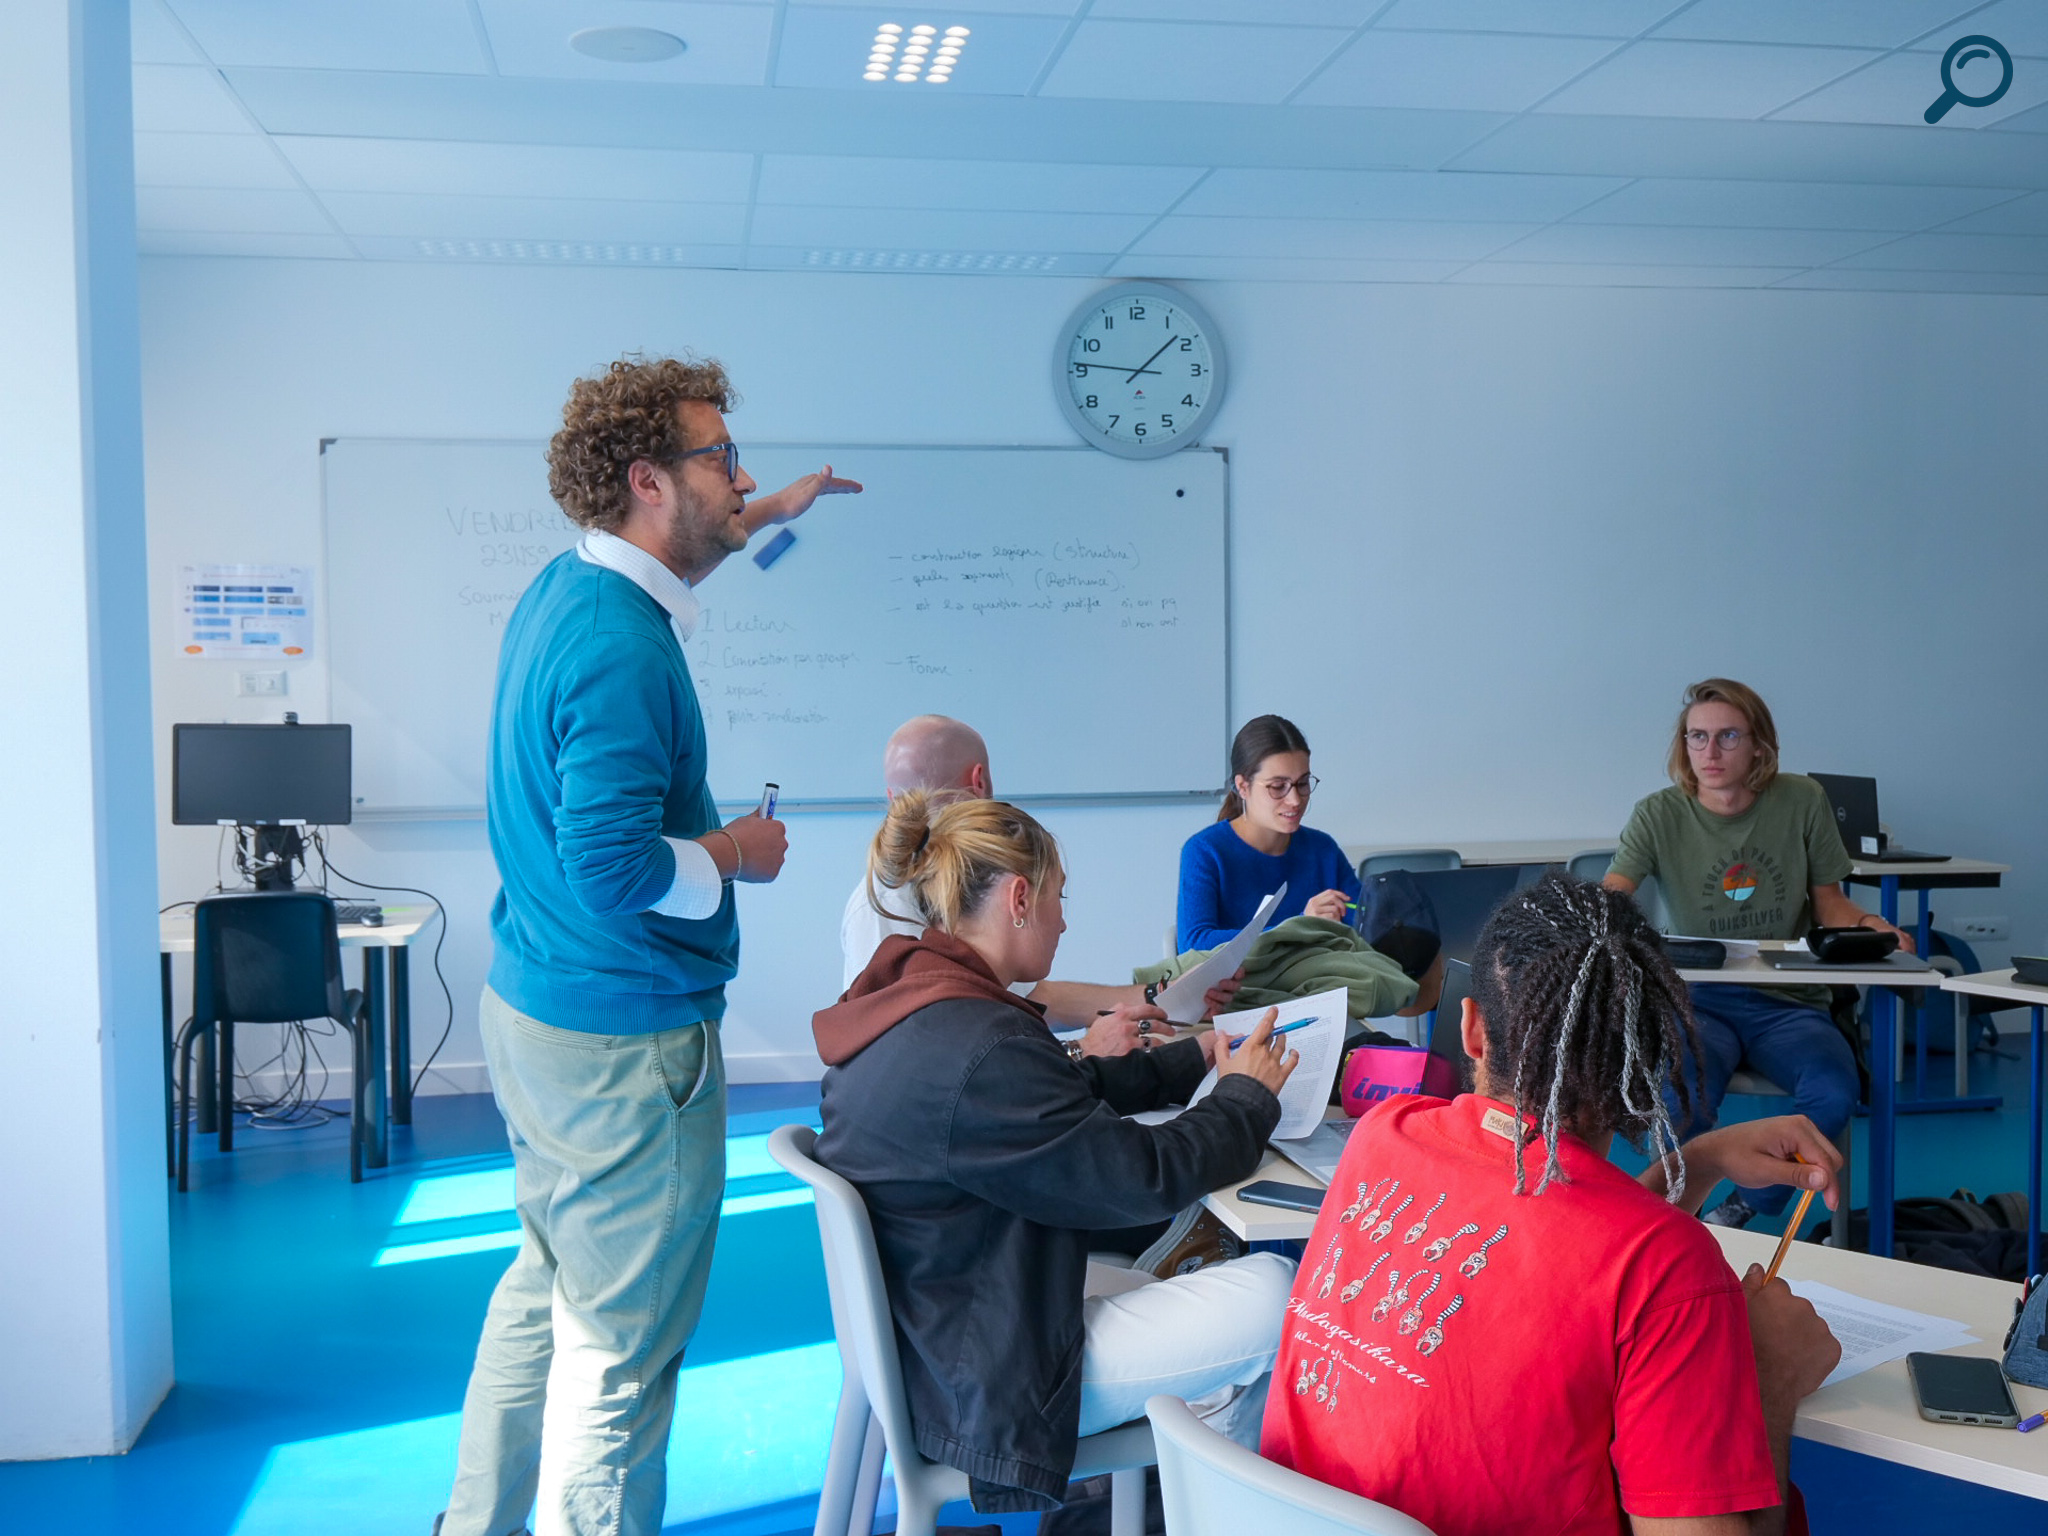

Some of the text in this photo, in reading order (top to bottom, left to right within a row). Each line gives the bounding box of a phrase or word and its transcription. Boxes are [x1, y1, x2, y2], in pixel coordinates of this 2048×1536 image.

[1129, 306, 1145, 320] 12
[1105, 316, 1113, 329] 11
[1165, 315, 1170, 329] 1
[1083, 338, 1101, 352] 10
[1180, 338, 1192, 351] 2
[1075, 364, 1088, 378] 9
[1190, 363, 1201, 377] 3
[1086, 395, 1098, 408] 8
[1181, 394, 1194, 407] 4
[1108, 414, 1120, 428] 7
[1161, 414, 1173, 427] 5
[1134, 423, 1147, 436] 6
[1709, 907, 1783, 934] QUIKSILVER
